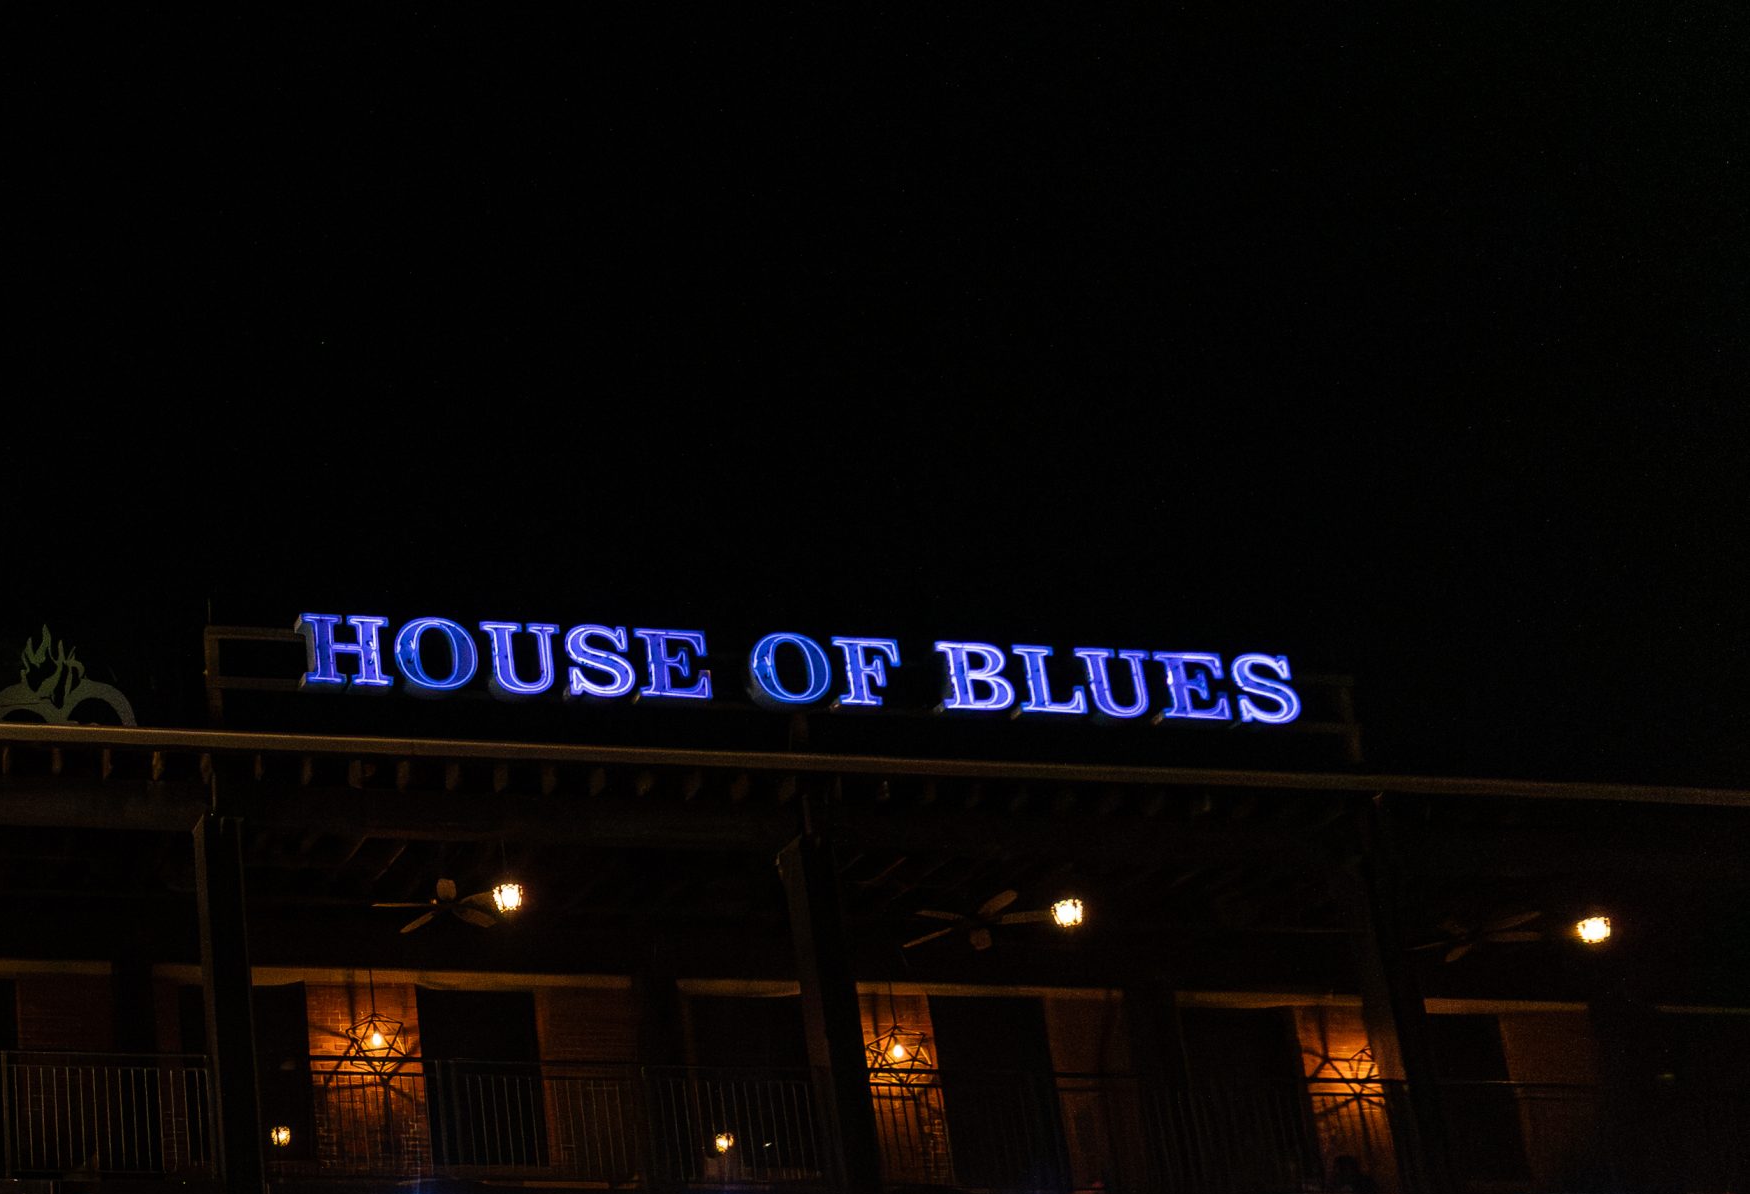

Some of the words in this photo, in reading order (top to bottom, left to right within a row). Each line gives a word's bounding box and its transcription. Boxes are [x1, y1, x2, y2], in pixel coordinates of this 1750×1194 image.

[297, 612, 712, 699] HOUSE
[751, 632, 900, 706] OF
[934, 641, 1301, 724] BLUES
